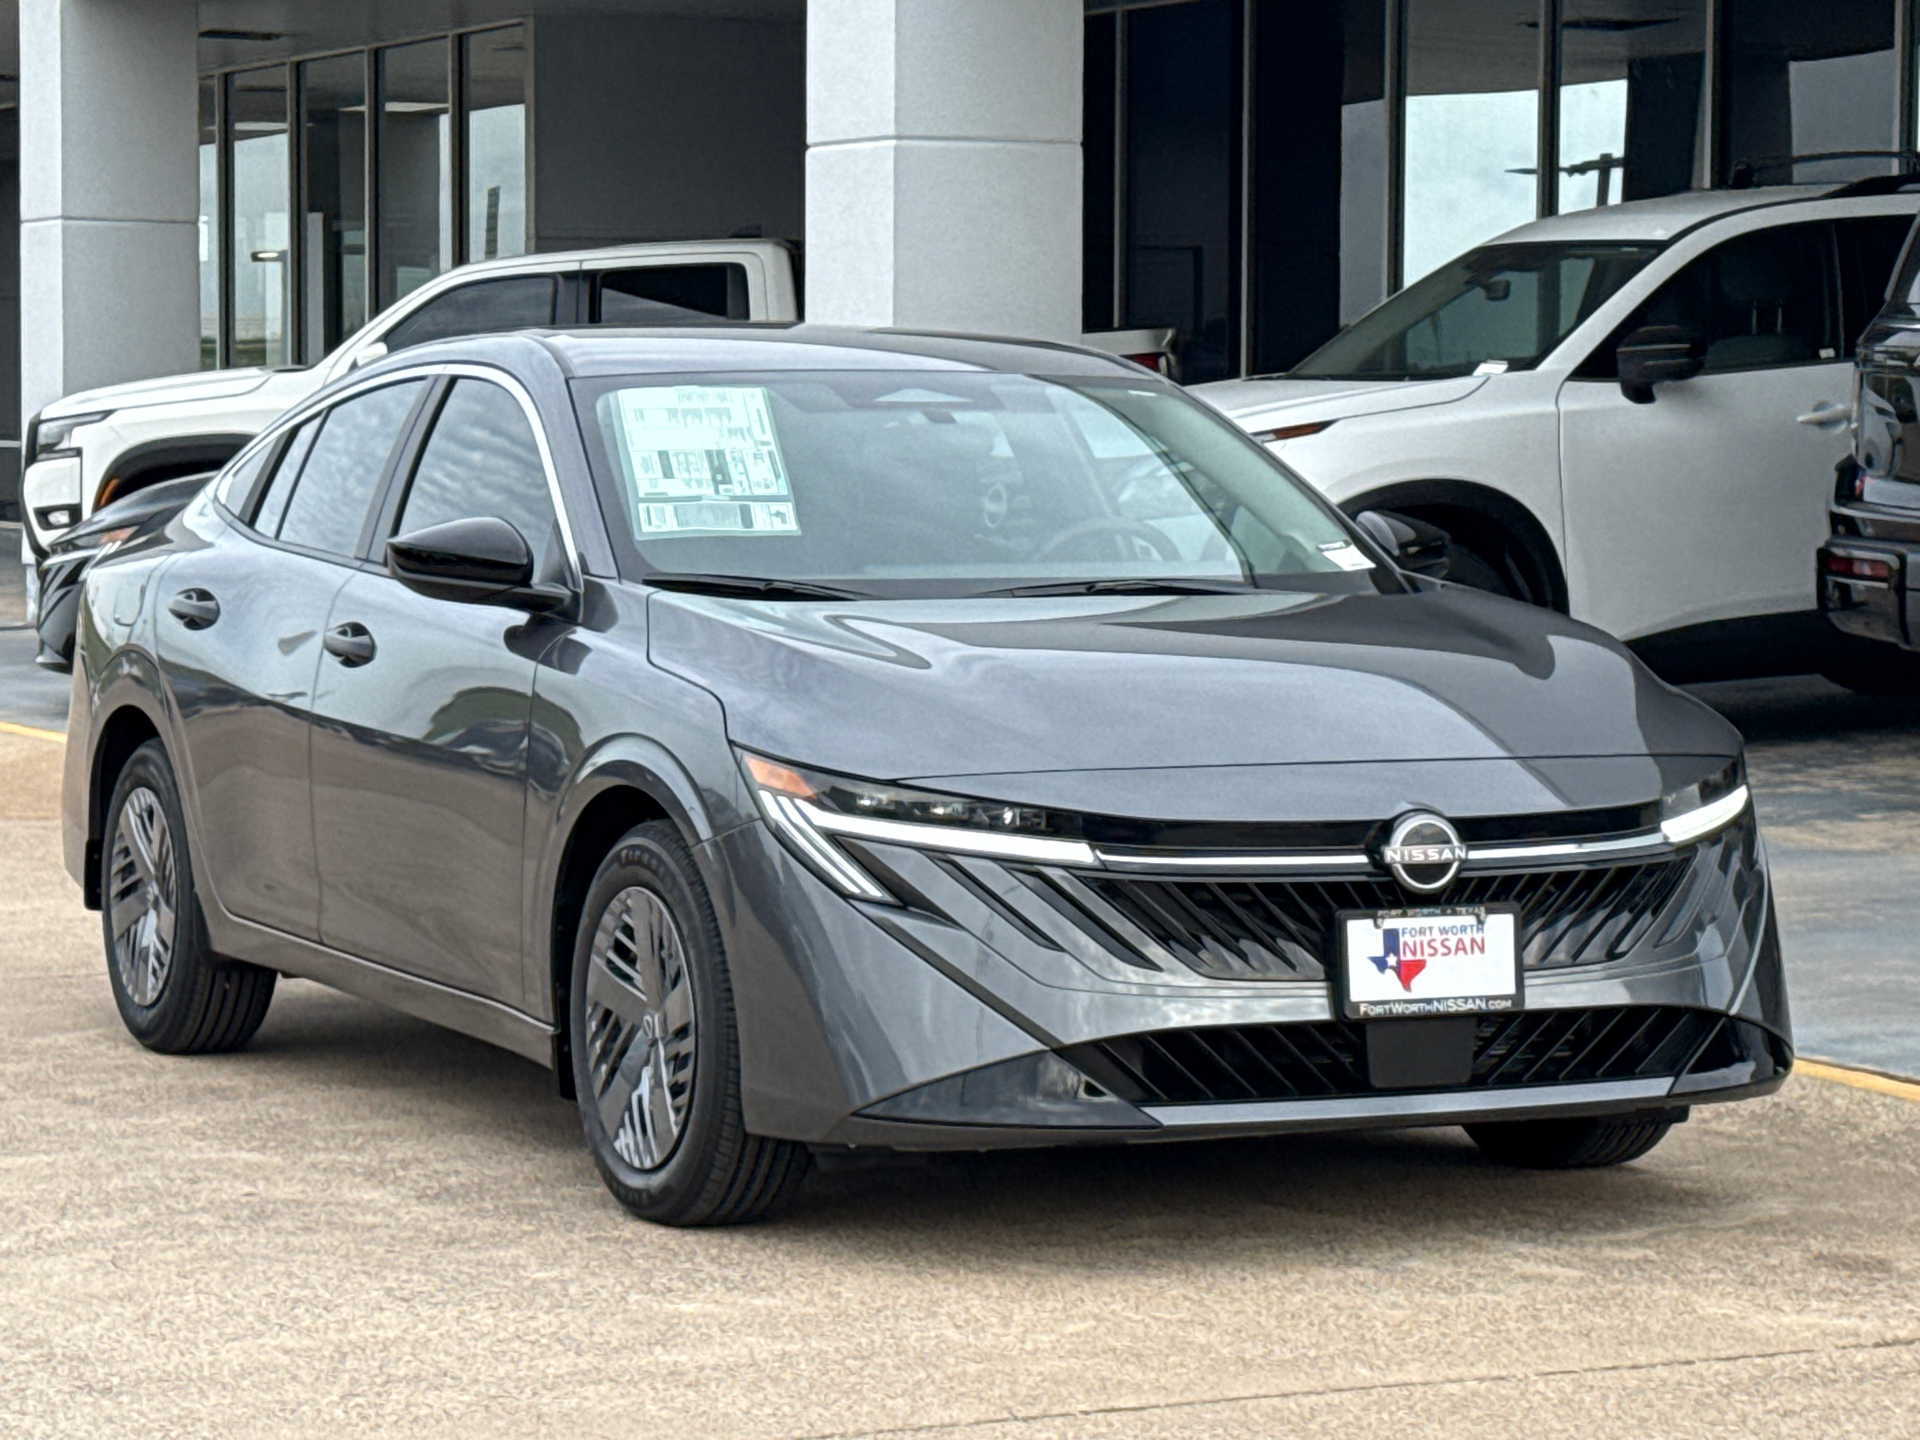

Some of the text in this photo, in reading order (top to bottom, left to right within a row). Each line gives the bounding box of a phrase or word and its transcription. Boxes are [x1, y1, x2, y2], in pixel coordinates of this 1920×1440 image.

[1386, 847, 1466, 862] NISSAN
[1401, 924, 1484, 938] FORT WORTH
[1402, 936, 1485, 957] NISSAN
